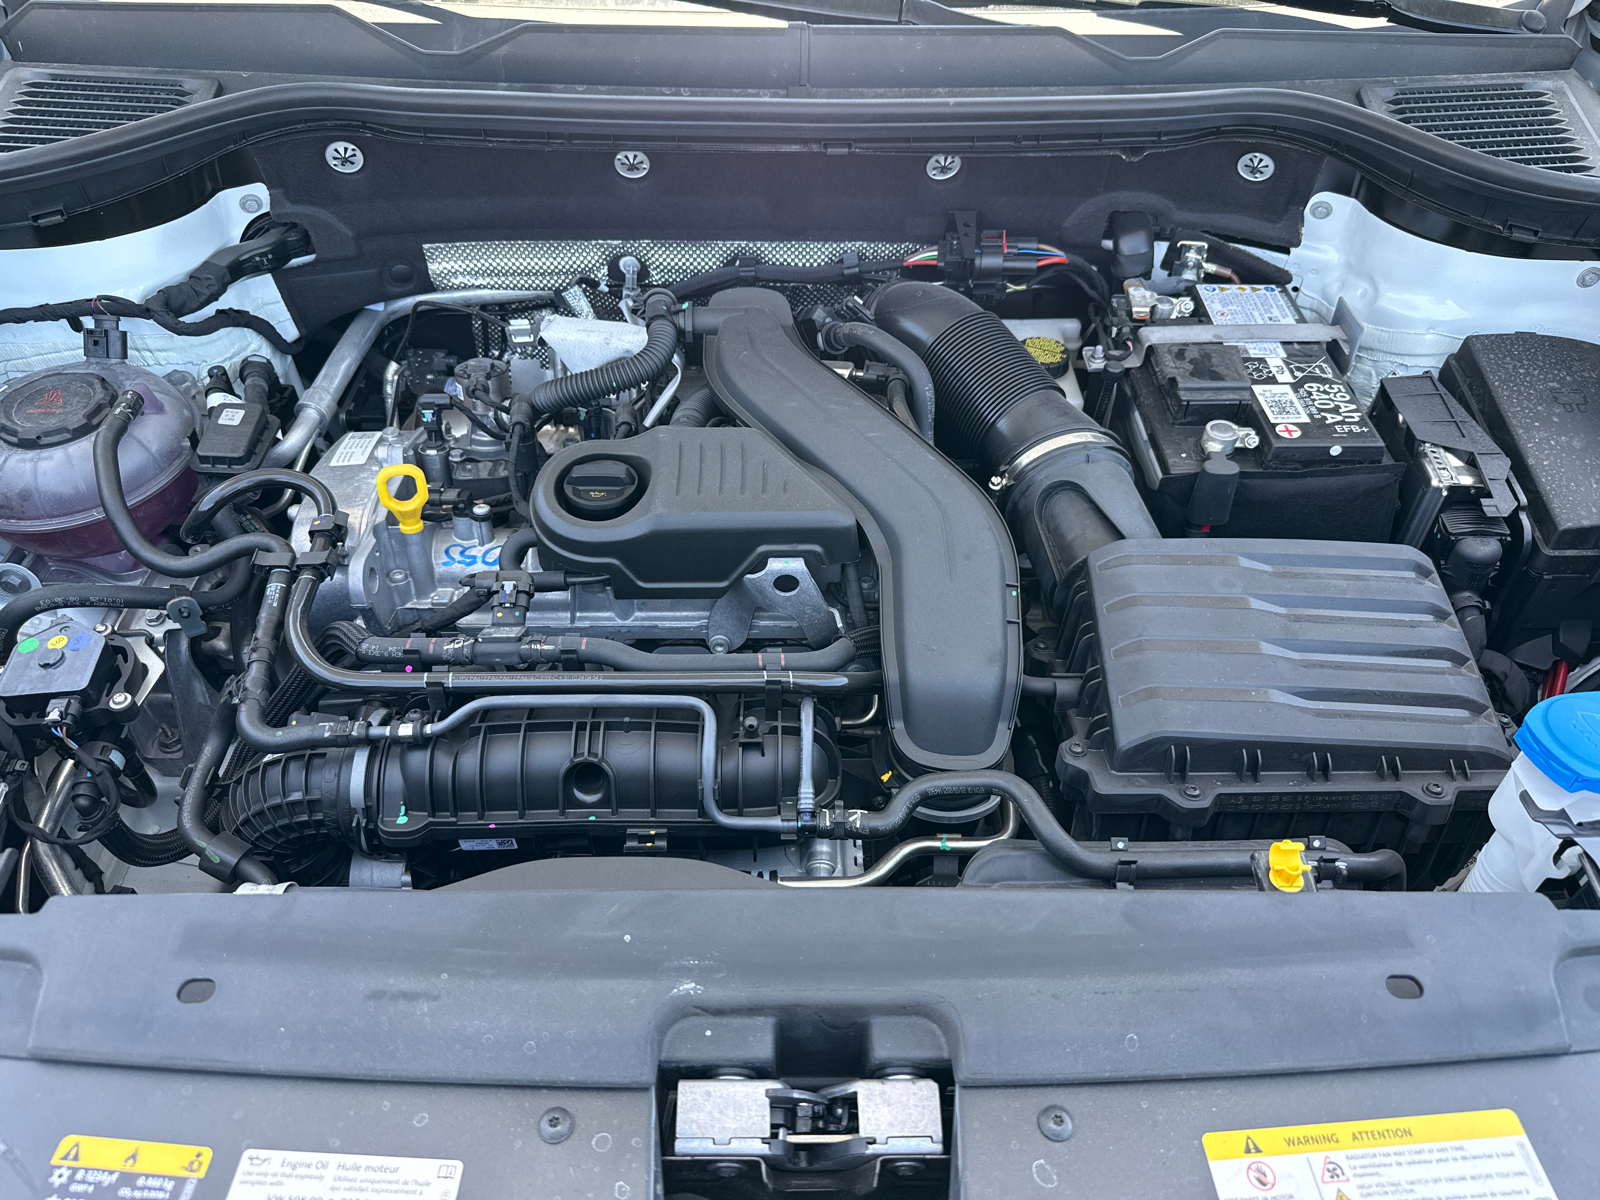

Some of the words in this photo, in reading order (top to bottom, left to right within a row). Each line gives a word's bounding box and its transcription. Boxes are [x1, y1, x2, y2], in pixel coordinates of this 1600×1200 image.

[1273, 365, 1286, 375] Pb
[1304, 382, 1336, 409] 640
[1320, 412, 1344, 424] A
[1323, 383, 1362, 422] 59Ah
[1334, 424, 1370, 433] EFB+
[1284, 1133, 1340, 1147] WARNING
[1351, 1127, 1413, 1142] ATTENTION
[280, 1158, 314, 1171] Engine
[315, 1160, 330, 1170] Oil
[336, 1160, 362, 1172] Huile
[364, 1163, 400, 1174] moteur
[256, 1170, 270, 1178] only
[270, 1170, 280, 1178] oil
[294, 1173, 324, 1182] expressly
[333, 1174, 358, 1184] Utilisez
[359, 1177, 400, 1186] uniquement
[402, 1178, 410, 1186] de
[330, 1184, 342, 1192] qui
